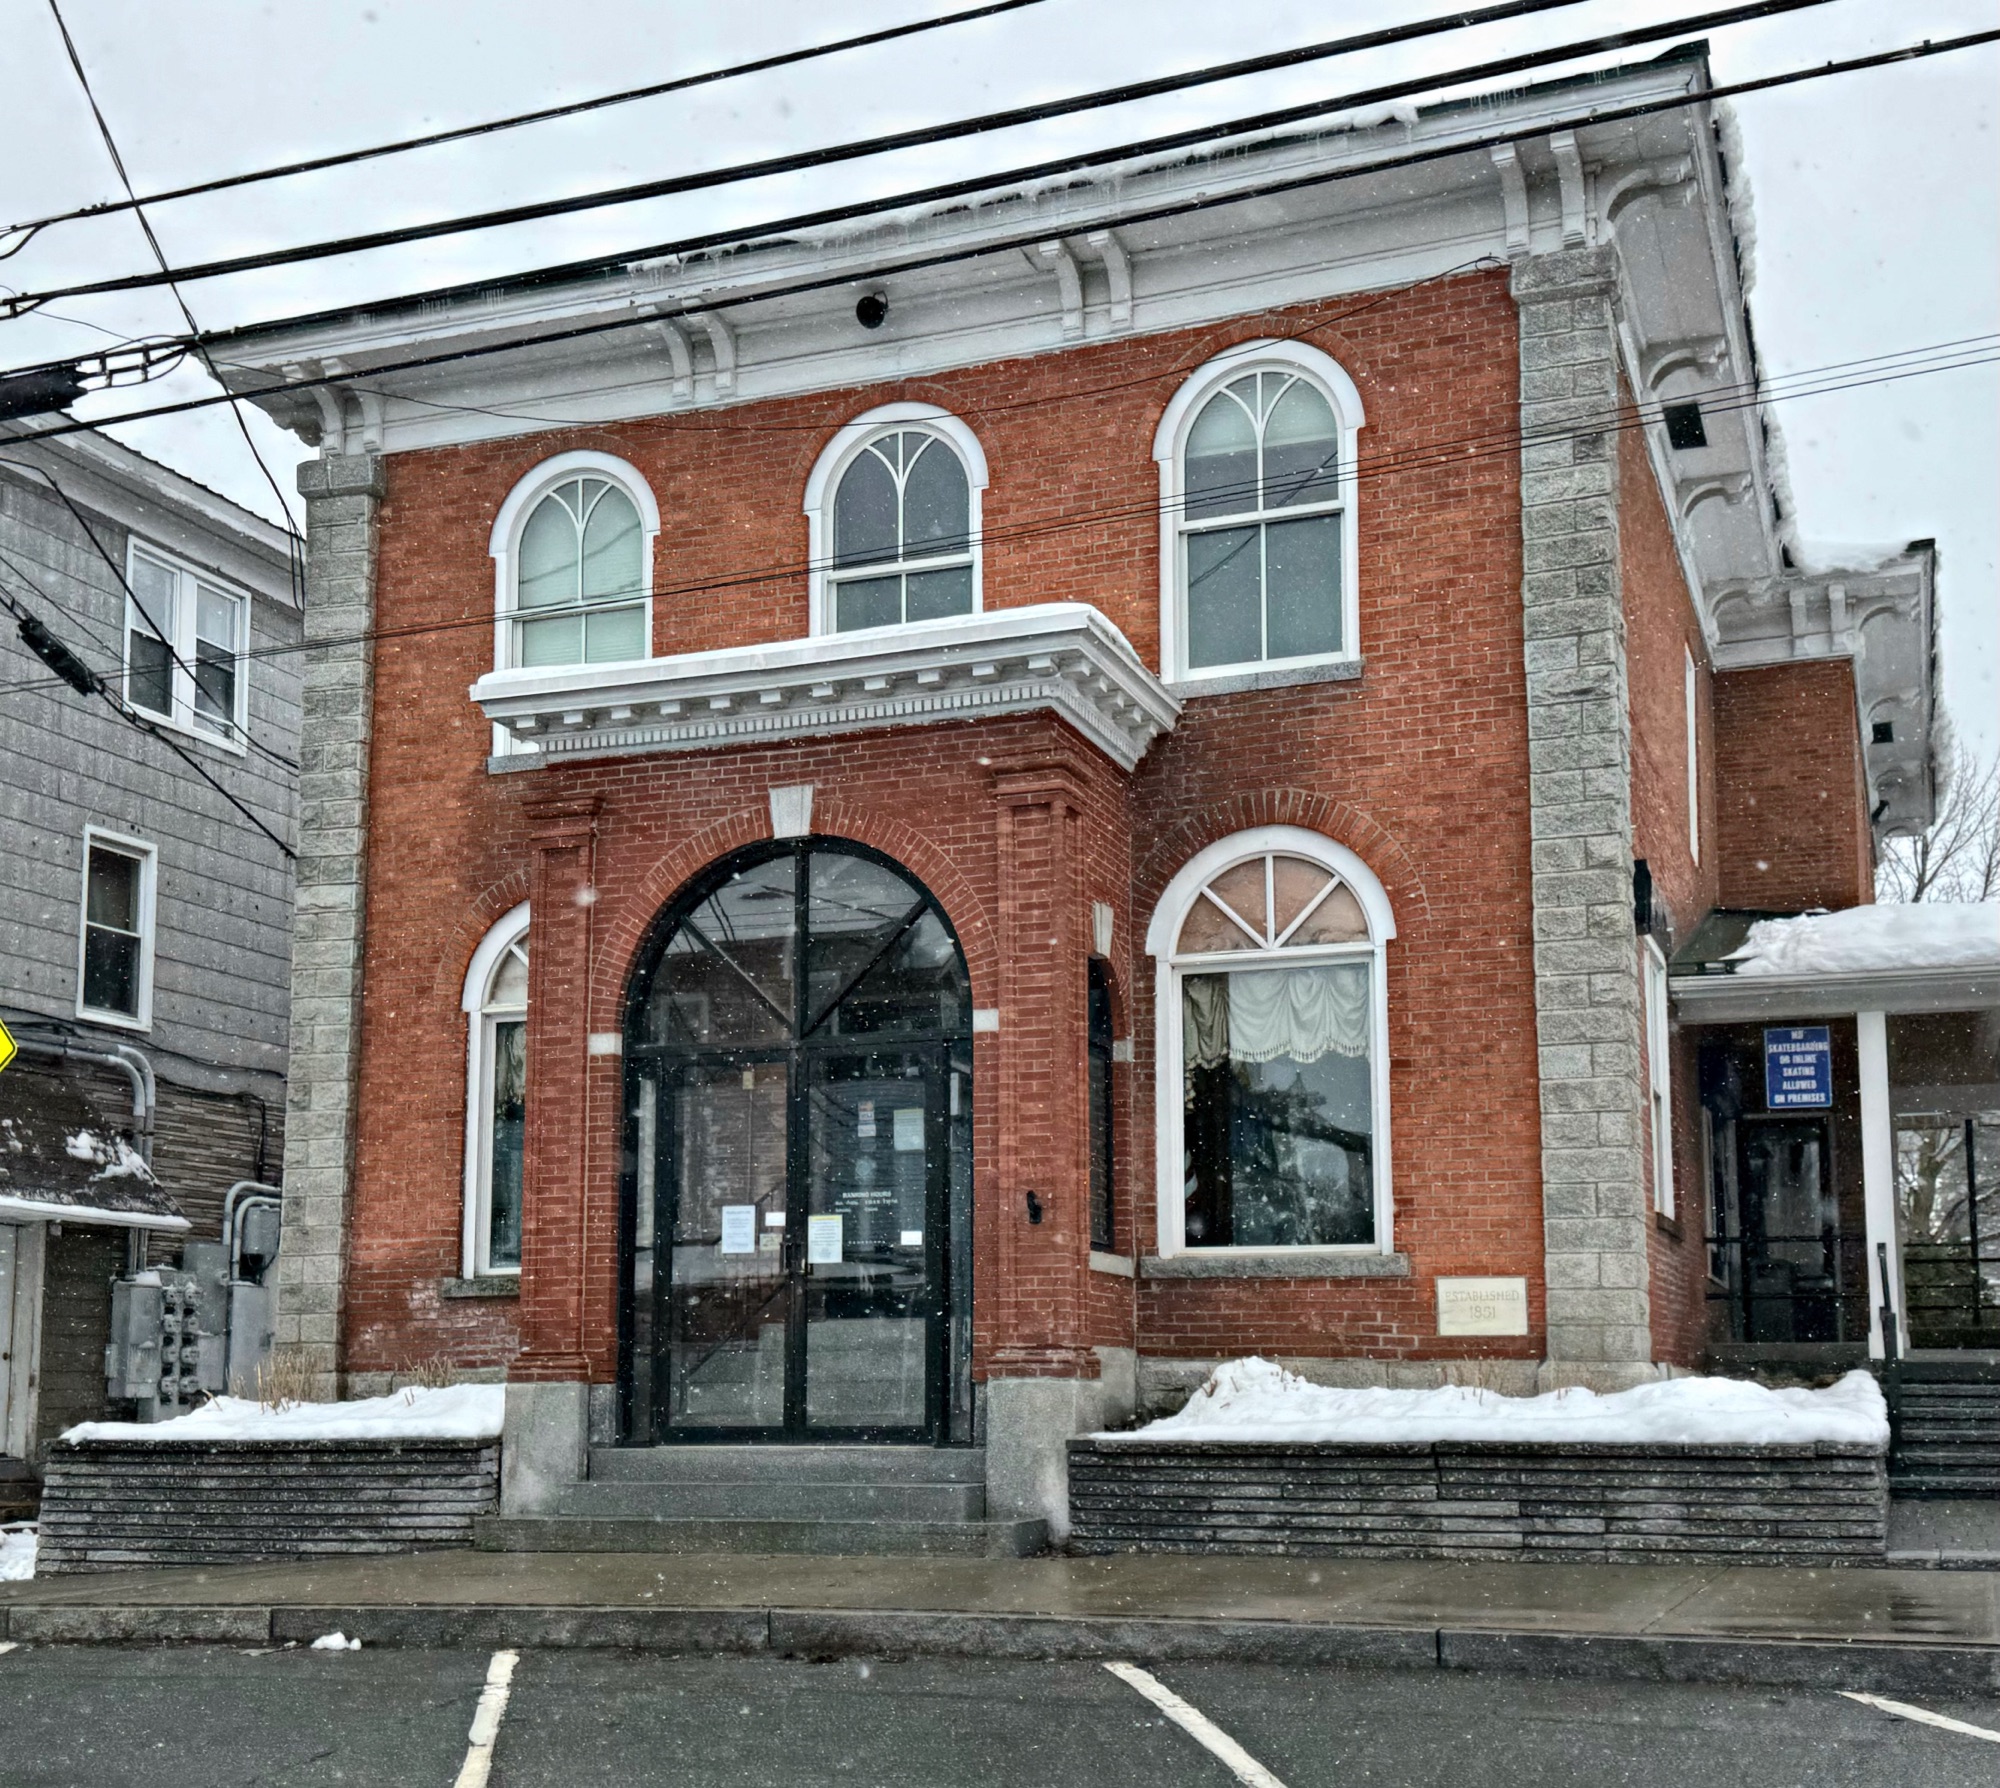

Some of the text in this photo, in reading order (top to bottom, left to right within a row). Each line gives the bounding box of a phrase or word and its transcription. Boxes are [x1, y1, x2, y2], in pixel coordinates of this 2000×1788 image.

[1768, 1042, 1829, 1053] SKATEBOARDING
[1782, 1066, 1816, 1077] SKATING
[1782, 1080, 1817, 1090] ALLOWED
[1774, 1092, 1826, 1104] ON PREMISES
[1445, 1290, 1520, 1302] ESTABLISHED
[1469, 1305, 1496, 1319] 1851
